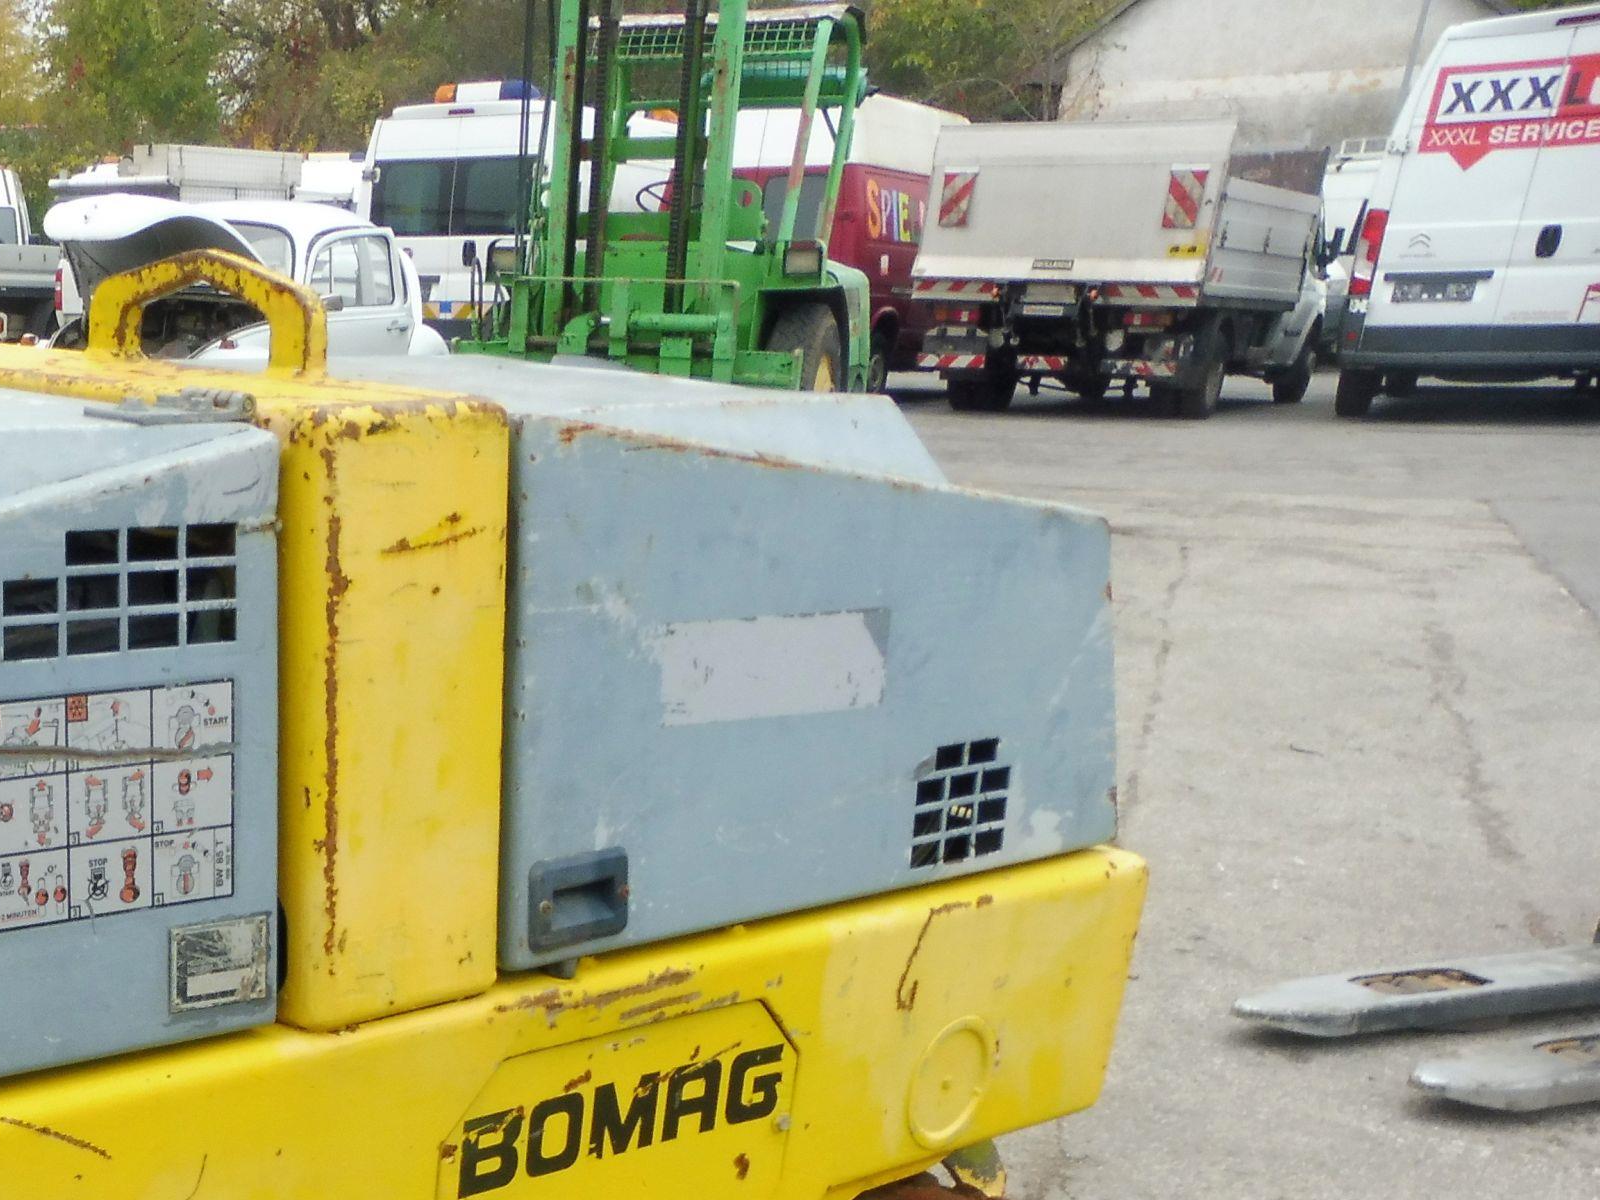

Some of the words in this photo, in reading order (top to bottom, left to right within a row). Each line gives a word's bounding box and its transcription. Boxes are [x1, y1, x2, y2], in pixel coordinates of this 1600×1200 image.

[1427, 126, 1481, 147] XXXL
[1488, 119, 1600, 144] SERVICE
[203, 716, 229, 727] START
[154, 839, 174, 848] STOP
[88, 858, 108, 868] STOP
[457, 1043, 785, 1199] BOMAG
